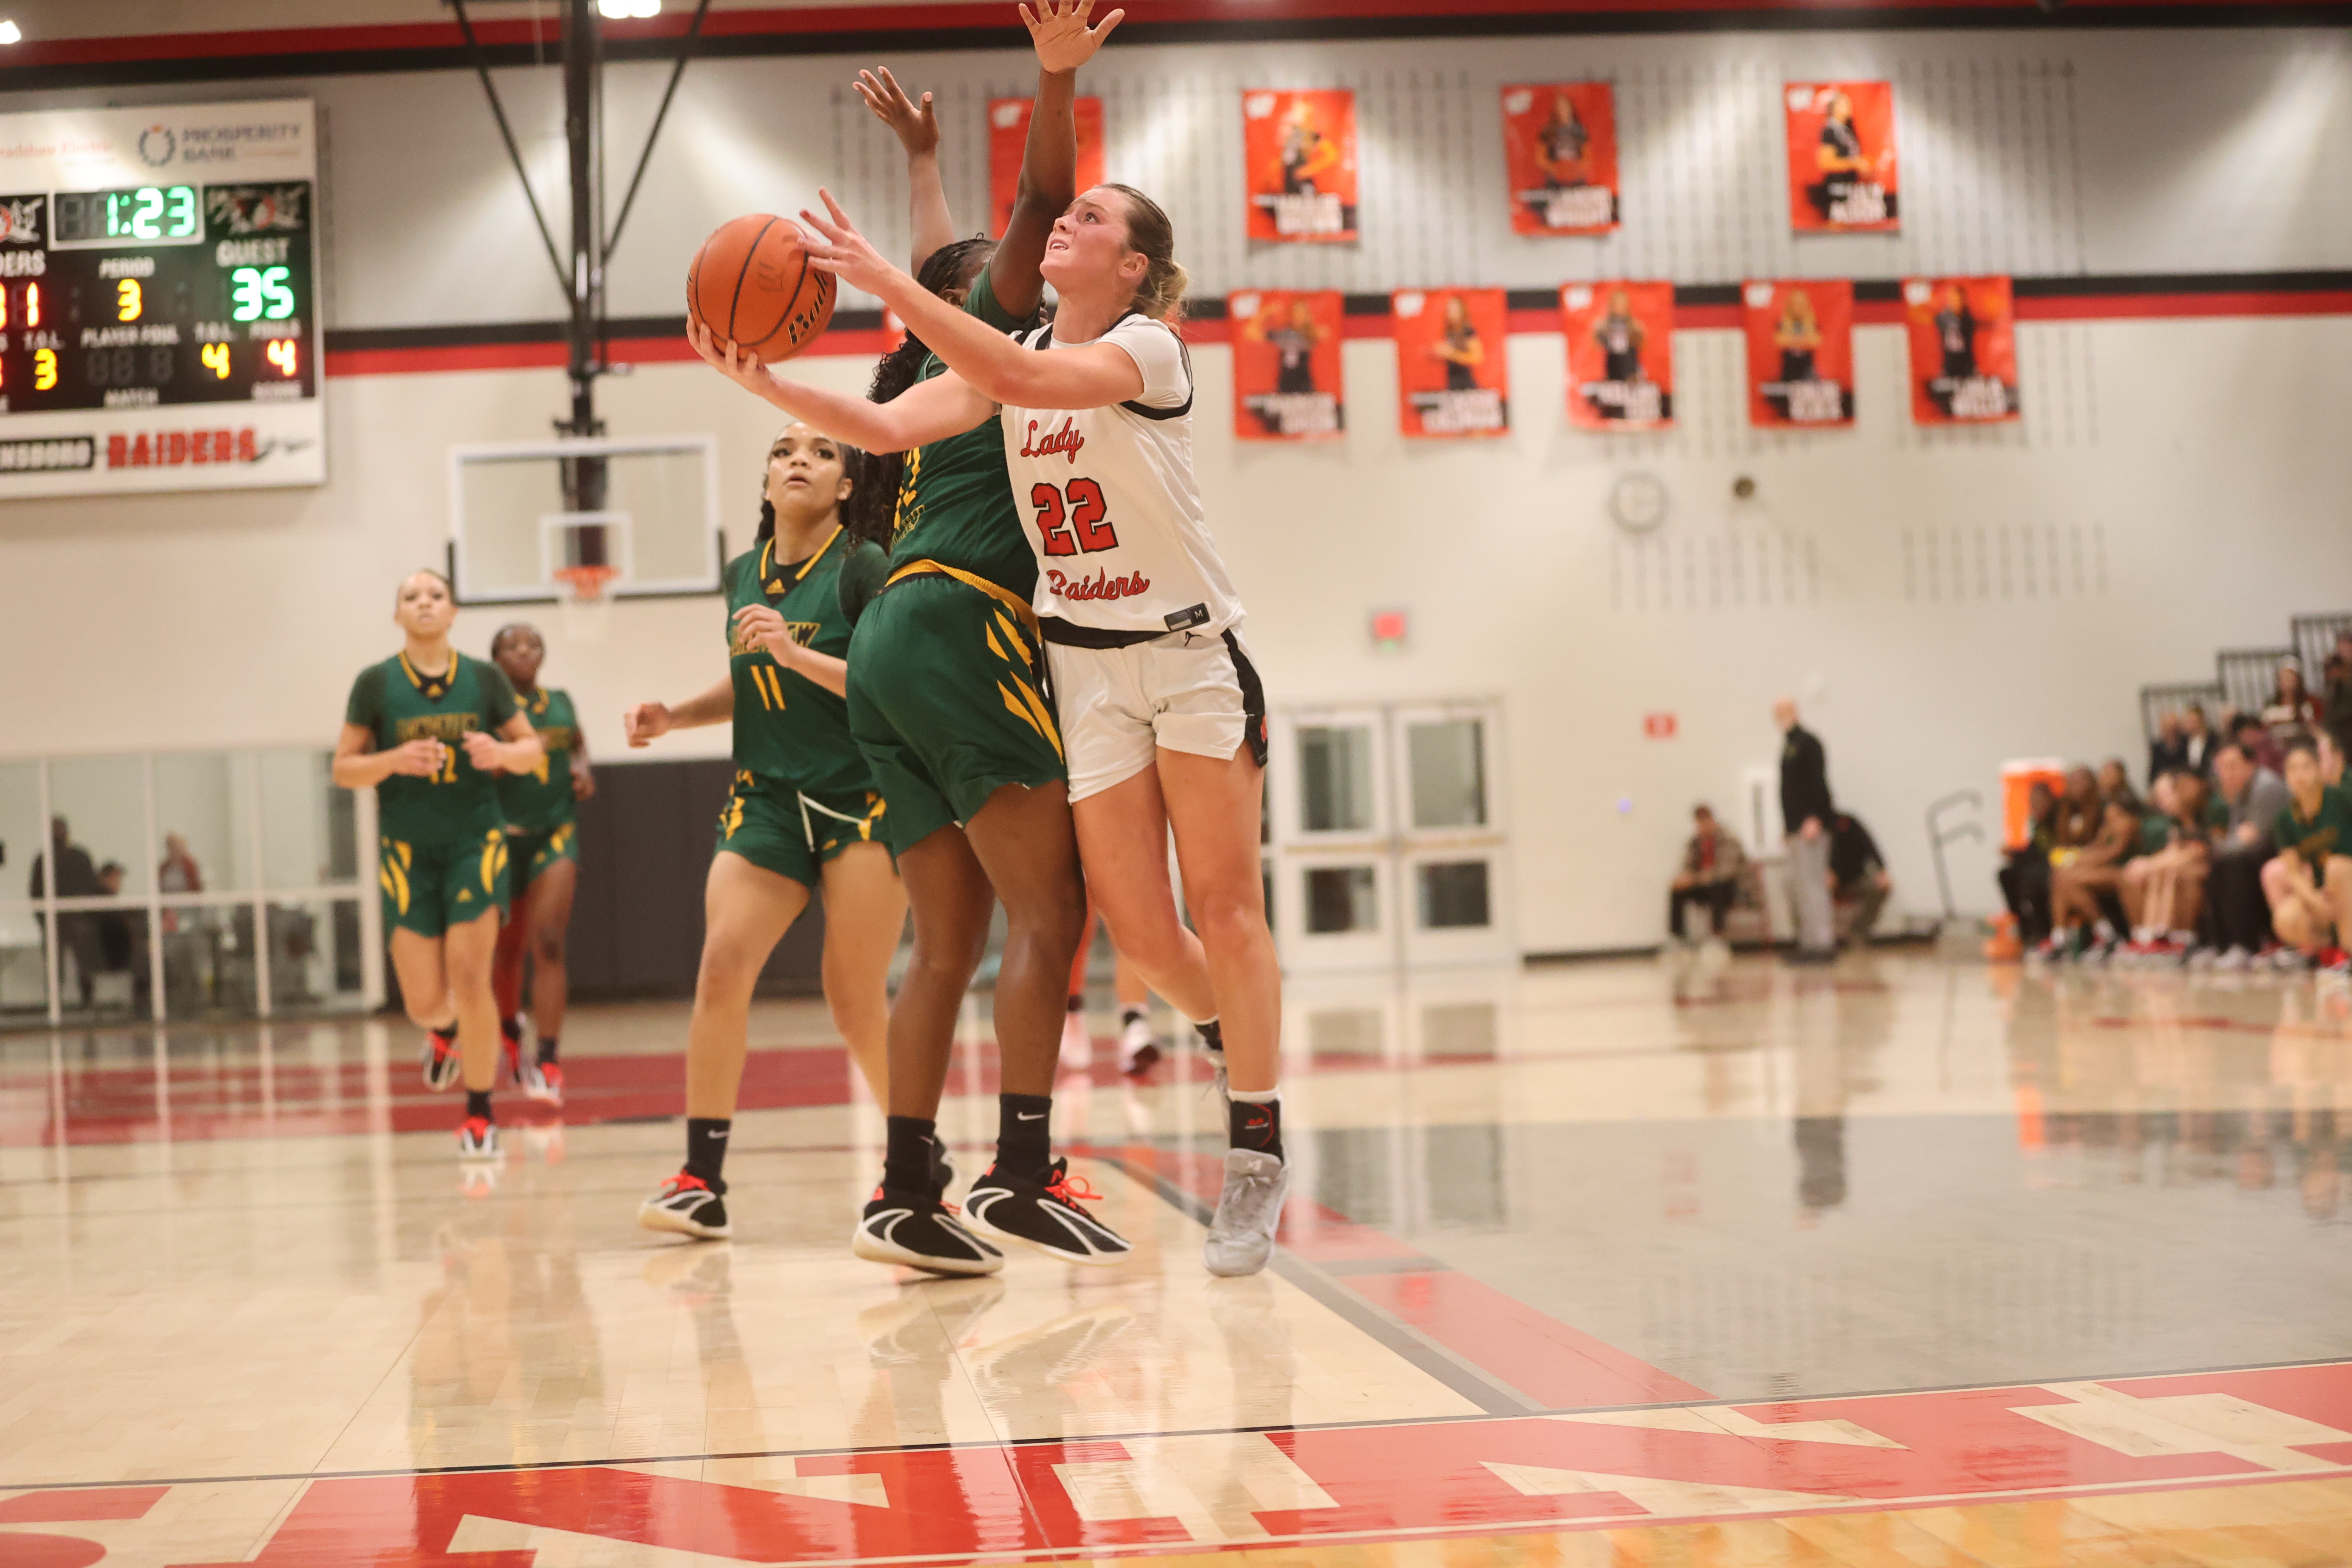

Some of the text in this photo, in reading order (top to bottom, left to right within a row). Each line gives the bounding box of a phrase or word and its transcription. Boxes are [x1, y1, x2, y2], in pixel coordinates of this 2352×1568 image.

[106, 186, 196, 239] 1:23
[99, 257, 156, 279] PERIOD
[216, 237, 290, 267] GUEST
[117, 278, 142, 322] 3
[231, 266, 297, 322] 35
[34, 348, 58, 390] 3
[201, 342, 231, 380] 4
[266, 338, 297, 377] 4
[107, 426, 257, 469] RAIDERS
[1020, 416, 1084, 464] Lady
[1031, 477, 1119, 557] 22
[1046, 566, 1150, 601] Raiders
[1194, 609, 1204, 619] M
[750, 665, 786, 711] 11
